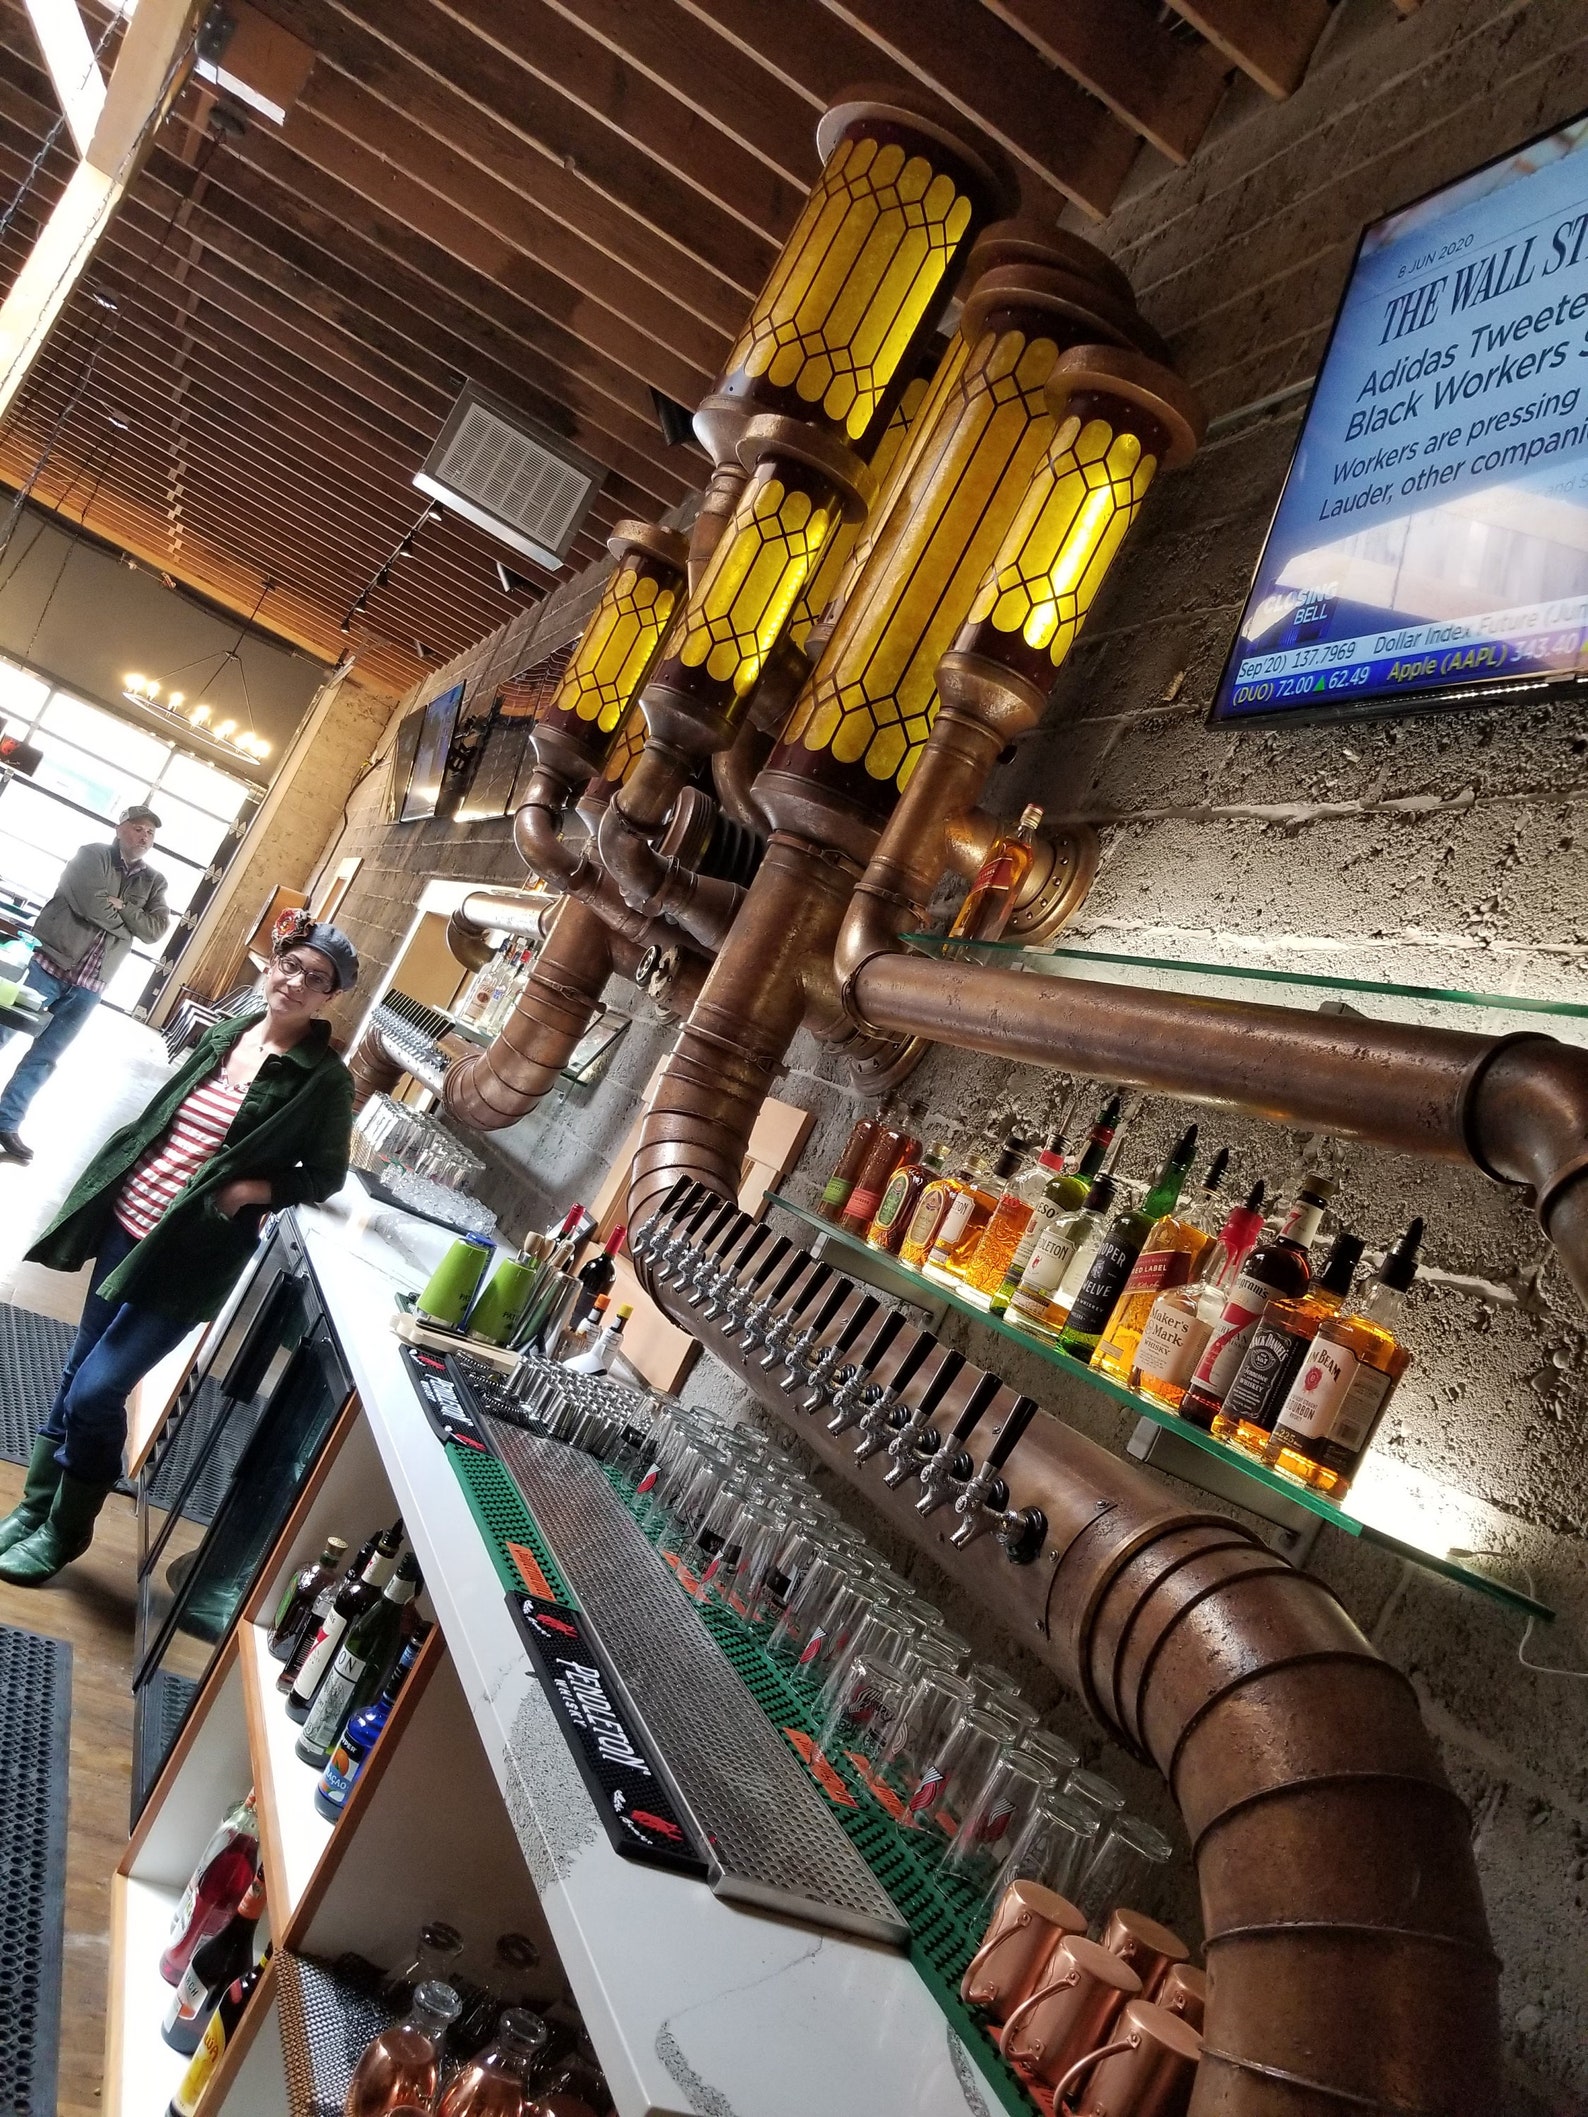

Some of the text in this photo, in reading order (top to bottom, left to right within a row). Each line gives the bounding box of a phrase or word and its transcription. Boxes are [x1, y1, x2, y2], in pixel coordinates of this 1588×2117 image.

[1409, 248, 1435, 275] JUN
[1440, 233, 1475, 261] 2020
[1379, 212, 1588, 347] THE WALL ST
[1356, 343, 1459, 403] Adidas
[1471, 290, 1588, 358] Tweete
[1344, 391, 1424, 442] Black
[1433, 338, 1570, 412] Workers
[1333, 385, 1581, 485] Workers are pressing
[1318, 481, 1394, 521] Lauder,
[1400, 461, 1466, 497] other
[1470, 421, 1588, 475] compani
[1264, 581, 1340, 615] CLOSING
[1293, 604, 1328, 626] BELL
[1291, 641, 1357, 669] 137.7969
[1373, 626, 1423, 655] Dollar
[1424, 619, 1471, 646] Index
[1476, 607, 1538, 638] Future
[1232, 630, 1580, 707] (DUO) 72.00 62.49 Apple (AAPL) 343.40
[1144, 1264, 1168, 1273] LABEL
[1151, 1307, 1190, 1334] Maker's
[1152, 1323, 1184, 1348] Mark
[1143, 1338, 1171, 1356] WHISKY
[1317, 1349, 1342, 1383] BEAM
[554, 1678, 588, 1728] WHISKY
[556, 1657, 649, 1771] PENDLETON
